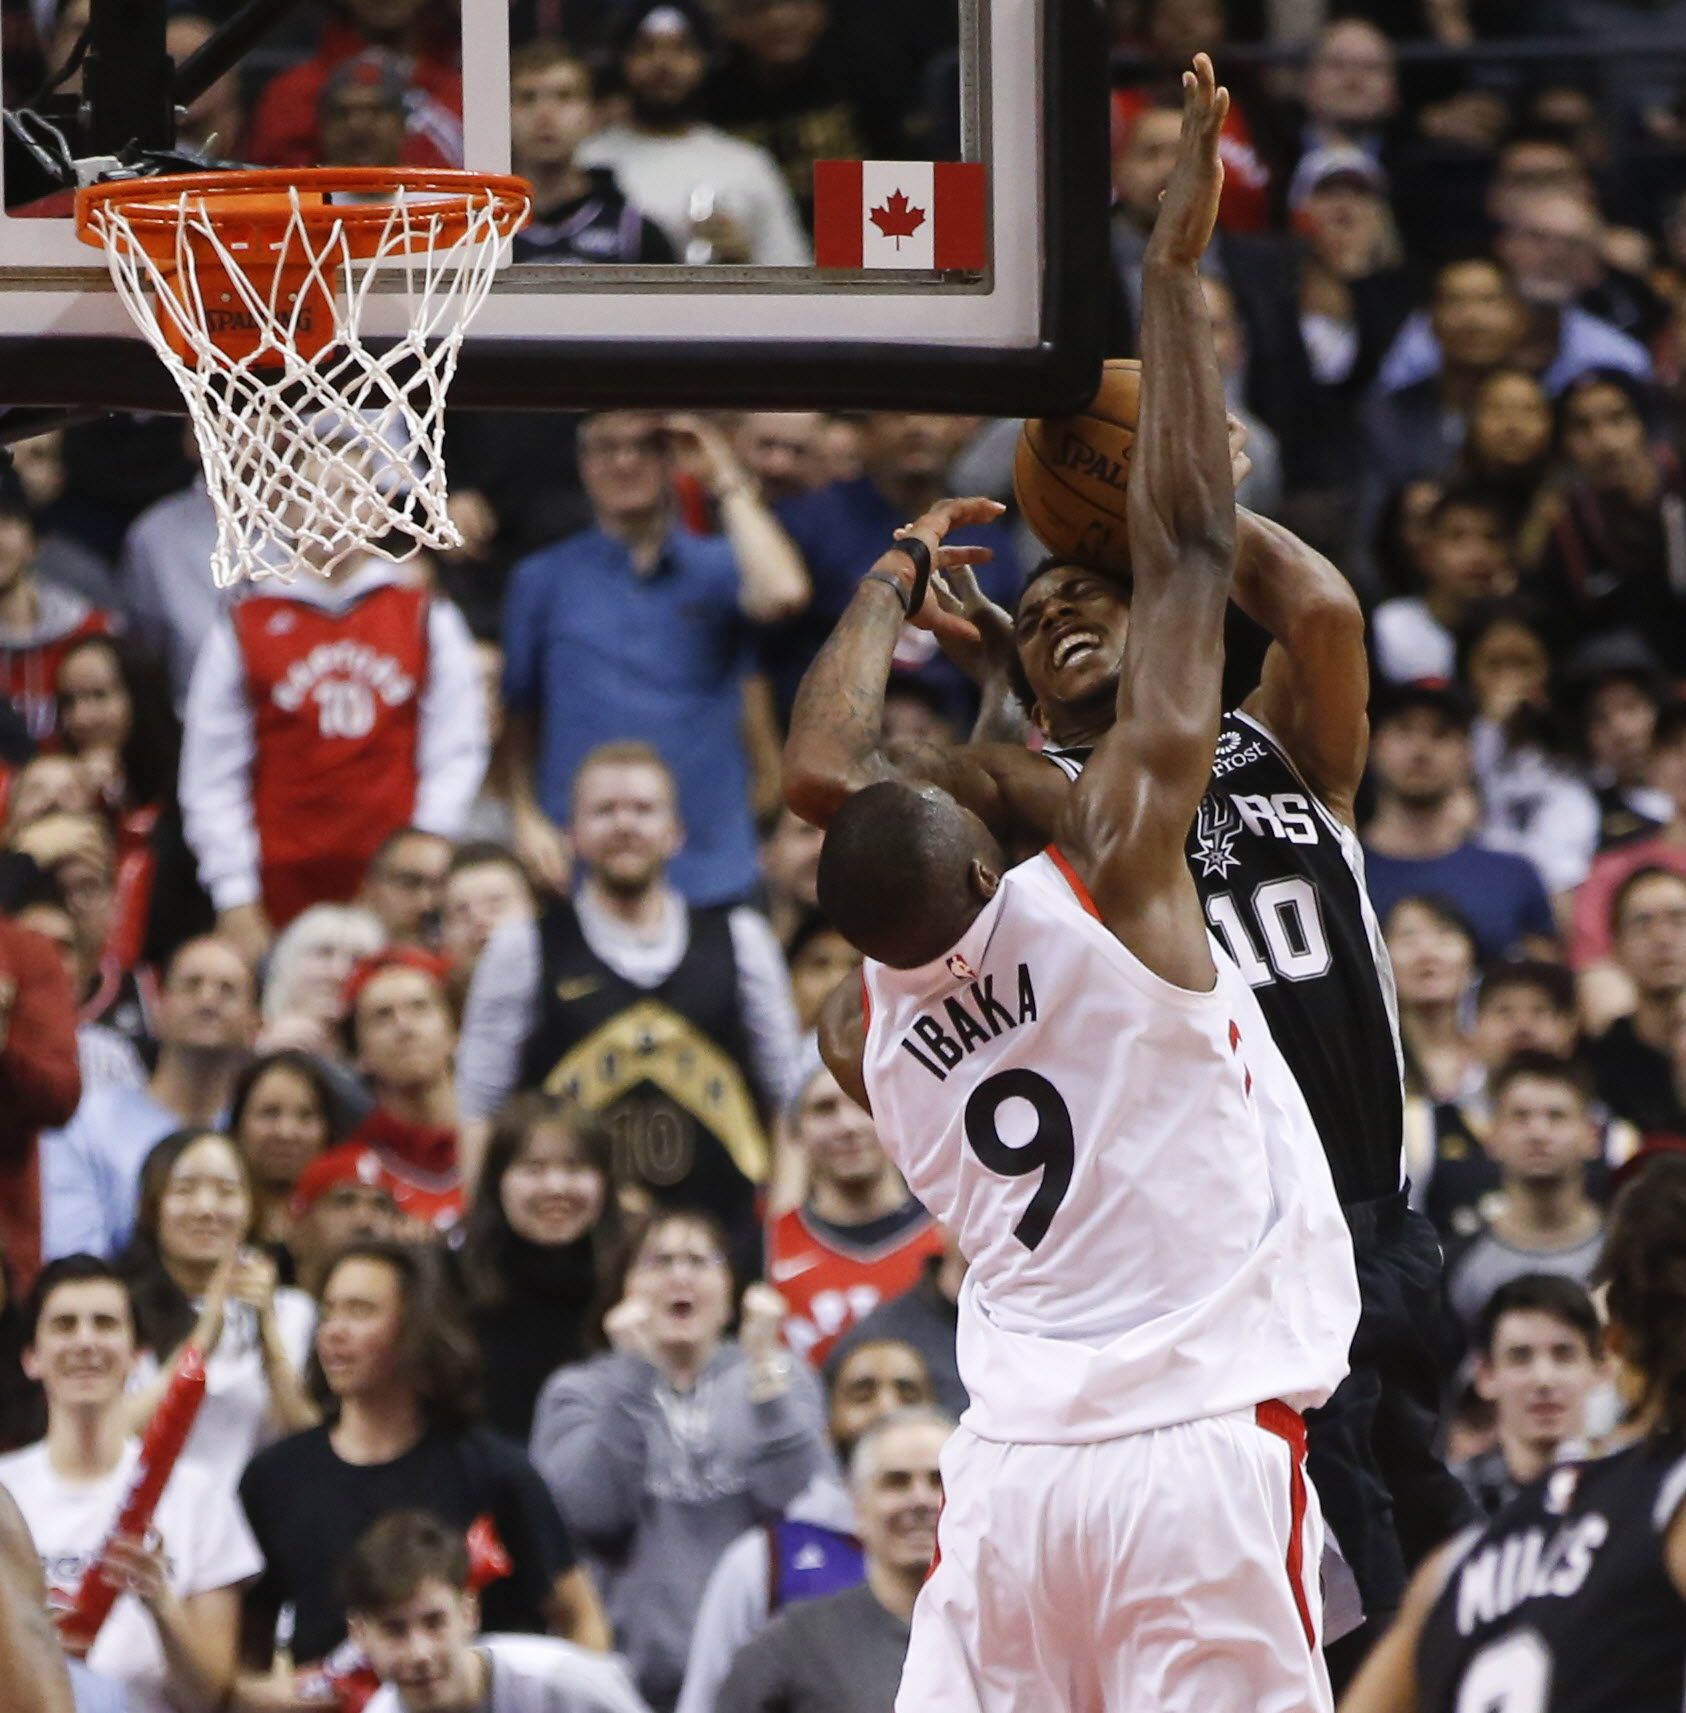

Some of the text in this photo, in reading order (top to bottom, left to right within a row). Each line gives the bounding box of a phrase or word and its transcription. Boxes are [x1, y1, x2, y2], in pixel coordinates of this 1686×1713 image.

[1211, 740, 1268, 779] Frost
[1205, 874, 1333, 989] 10
[901, 963, 1038, 1082] IBAKA
[964, 1067, 1075, 1252] 9
